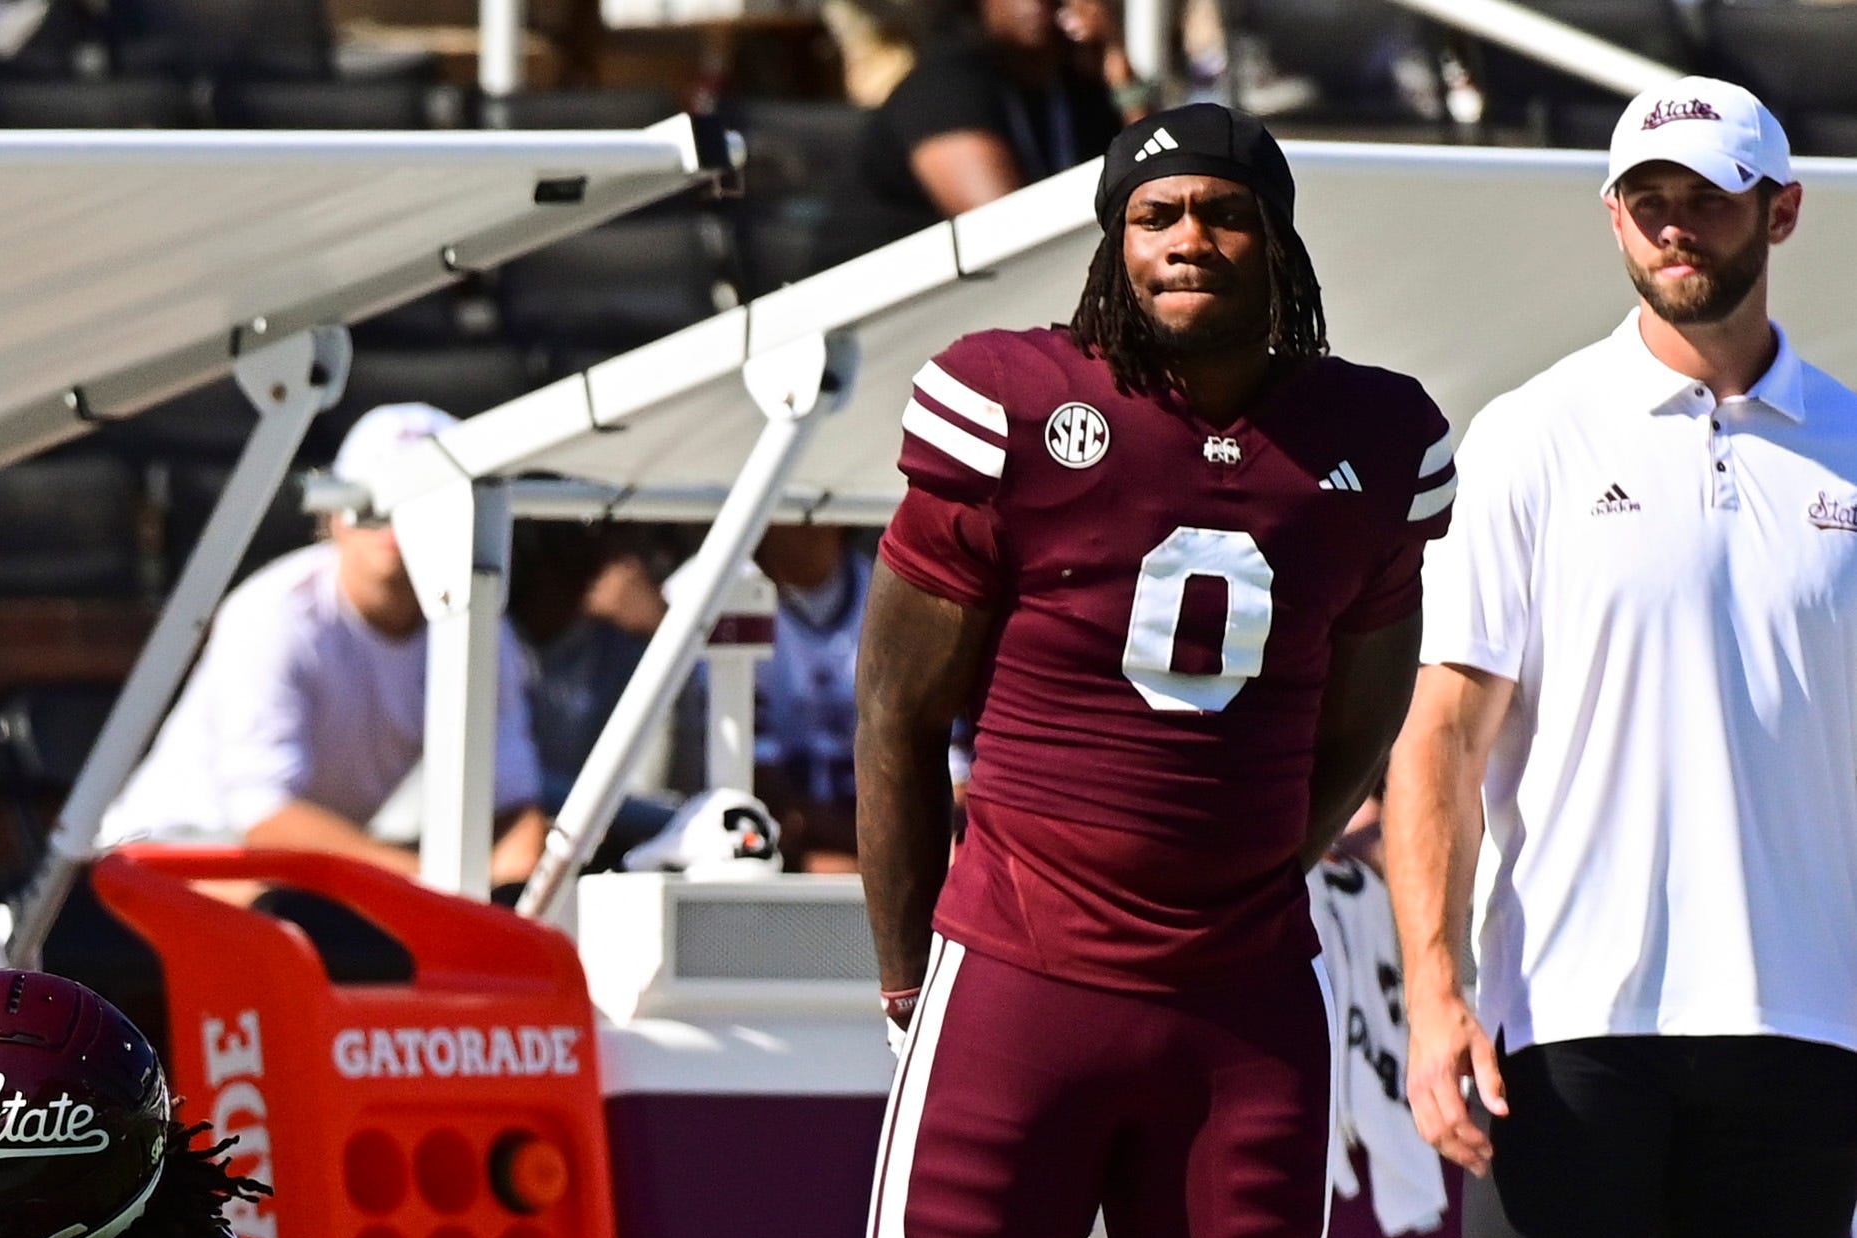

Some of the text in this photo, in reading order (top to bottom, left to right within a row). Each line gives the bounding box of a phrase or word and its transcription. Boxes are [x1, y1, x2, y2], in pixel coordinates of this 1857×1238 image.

[1641, 98, 1722, 130] State
[1049, 405, 1107, 465] SEC
[1808, 490, 1857, 531] Stat
[1122, 526, 1274, 712] 0
[332, 1027, 580, 1078] GATORADE
